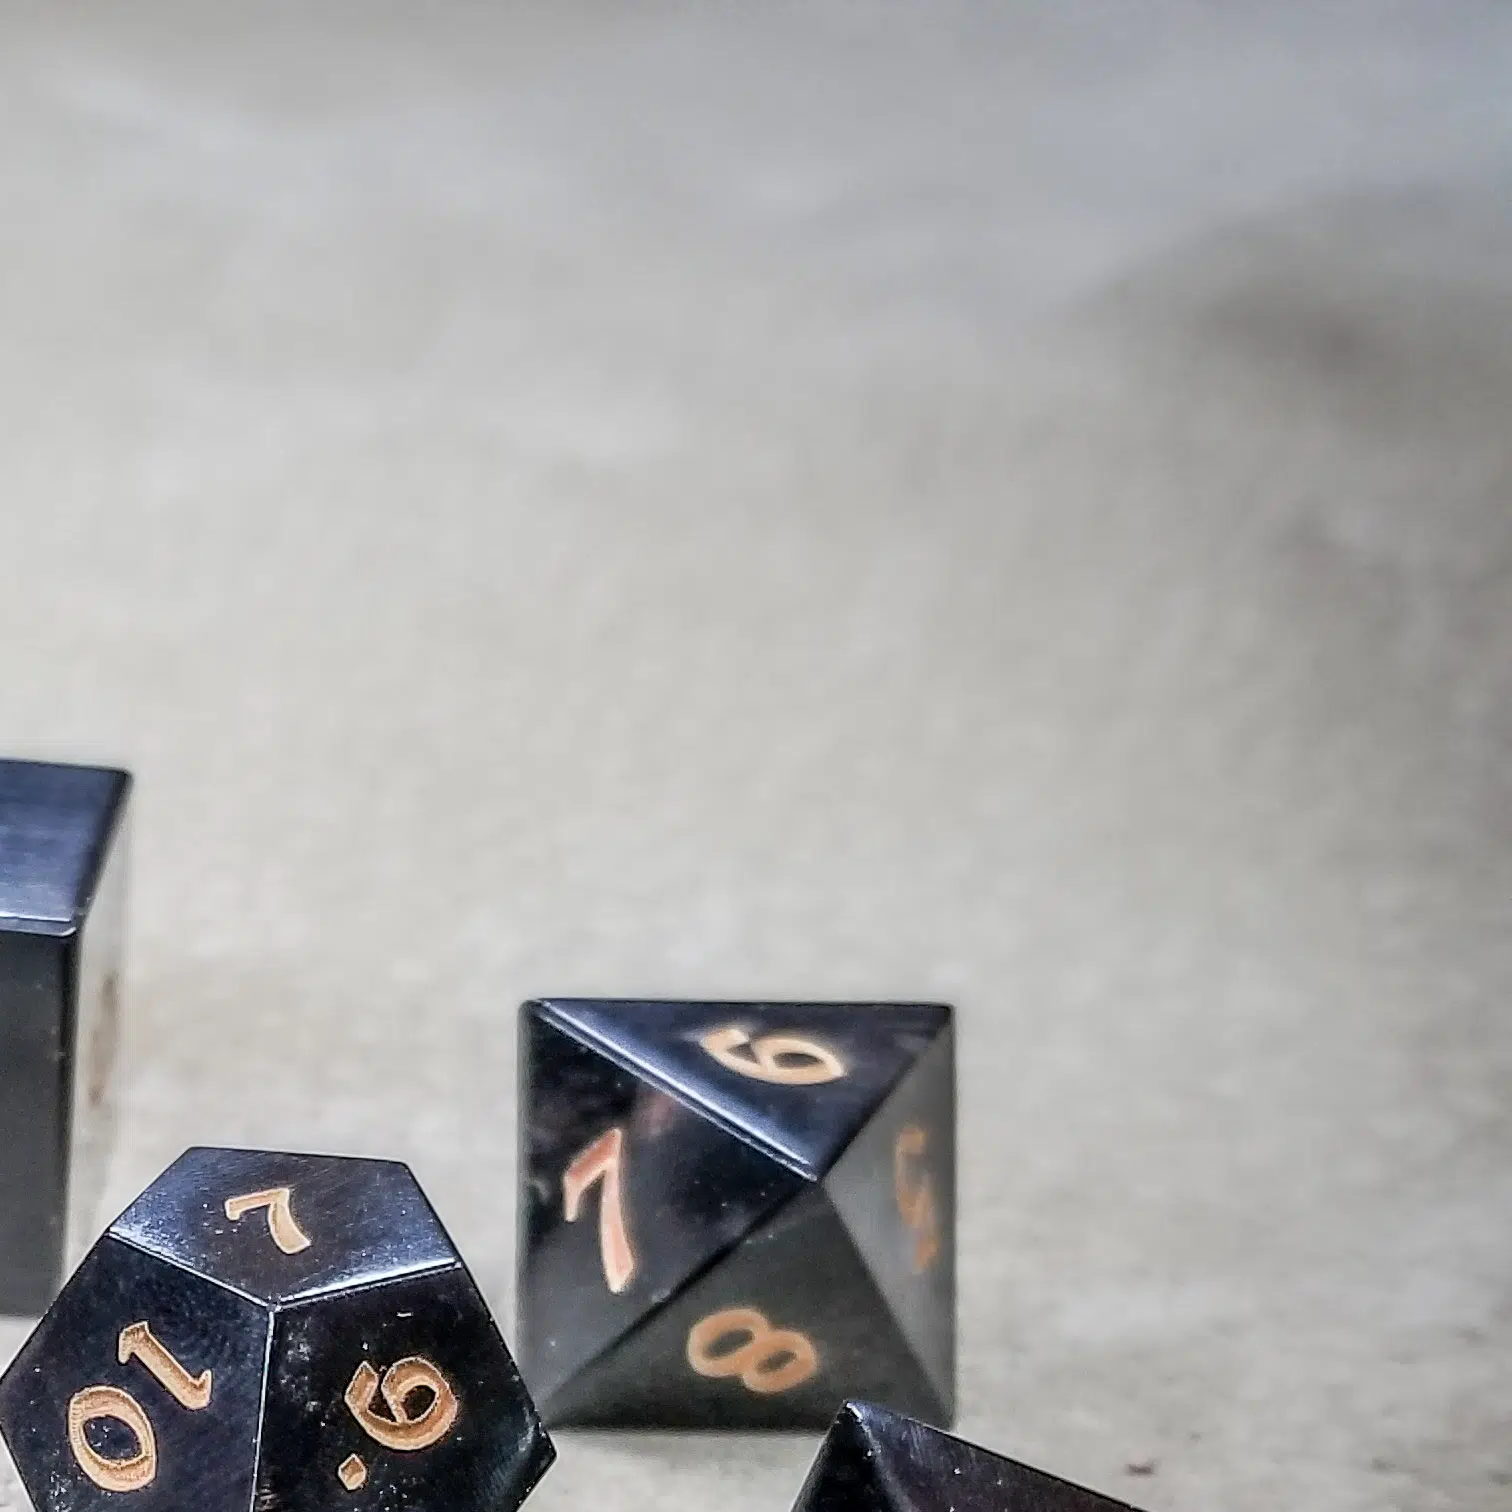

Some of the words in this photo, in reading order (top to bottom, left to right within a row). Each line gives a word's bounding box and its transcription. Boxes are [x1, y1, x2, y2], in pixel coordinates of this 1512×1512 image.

[699, 1026, 849, 1086] 6
[225, 1187, 313, 1256] 7
[562, 1127, 638, 1295] 7
[686, 1306, 820, 1395] 8
[67, 1320, 213, 1493] 10
